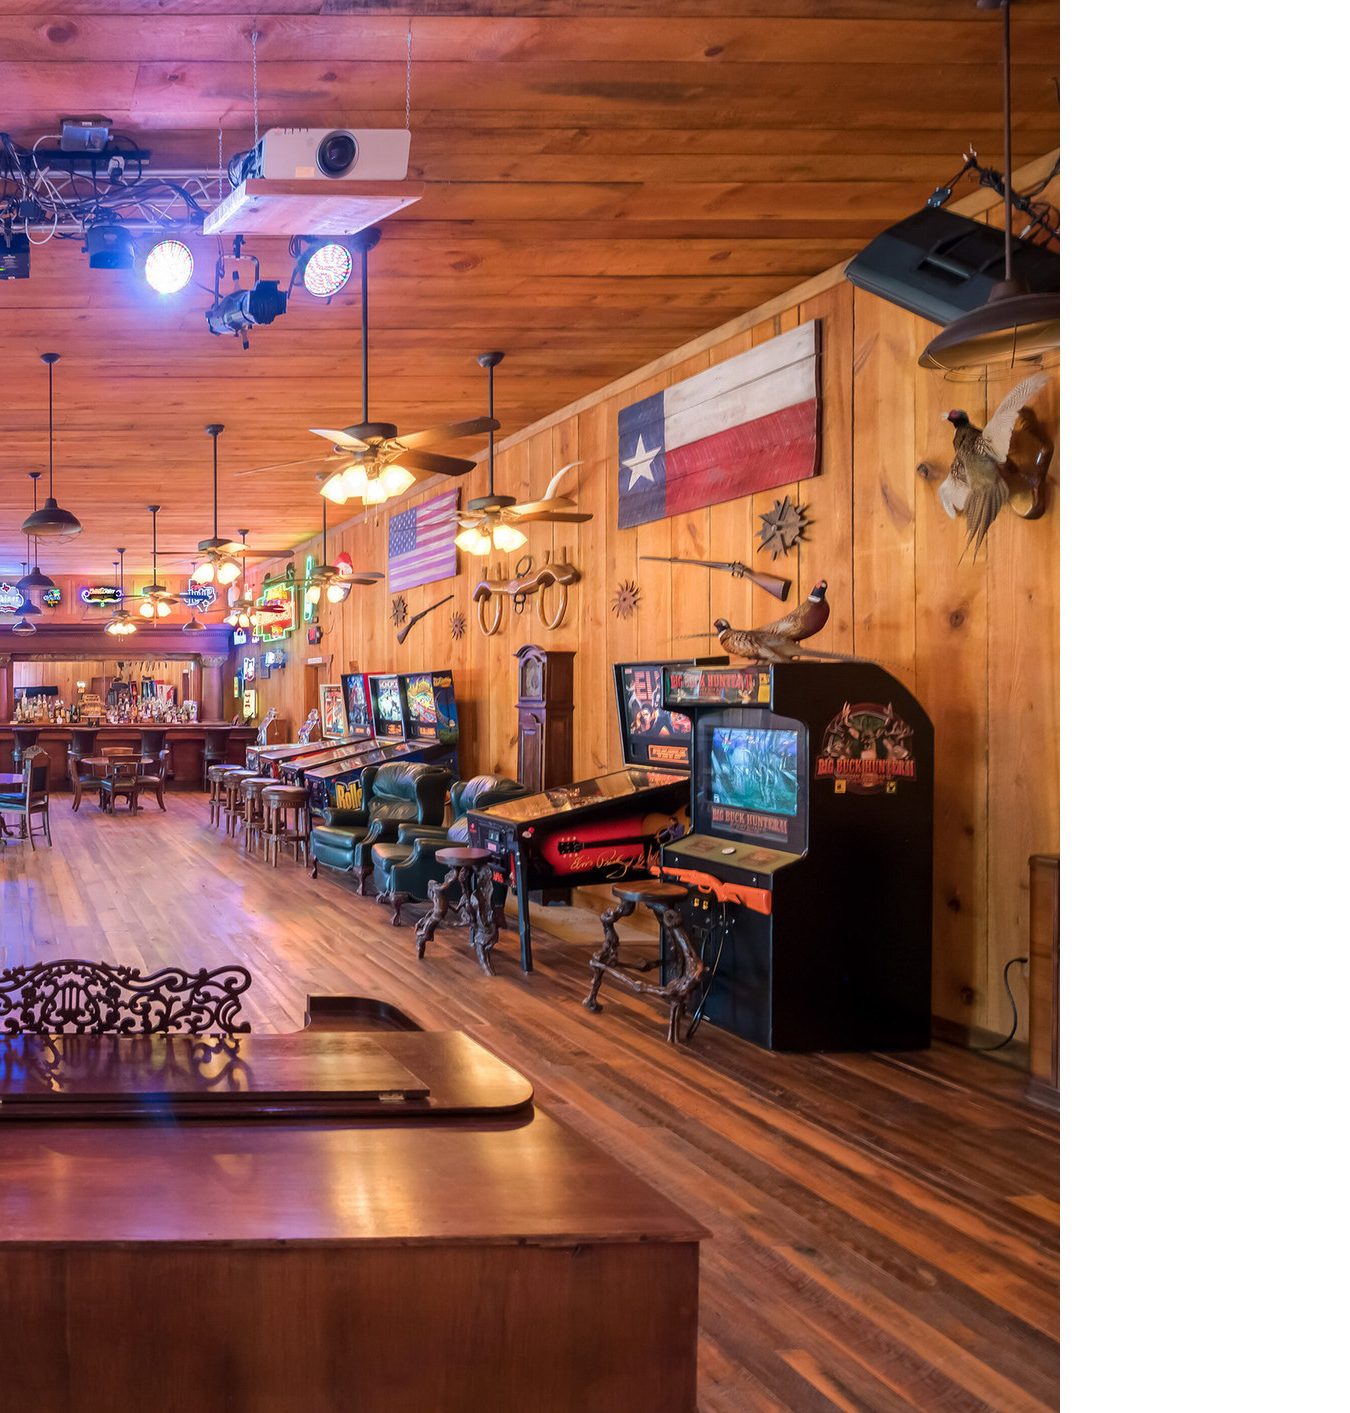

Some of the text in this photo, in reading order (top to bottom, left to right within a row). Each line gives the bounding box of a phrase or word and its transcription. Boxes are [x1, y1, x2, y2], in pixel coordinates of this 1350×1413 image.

[670, 674, 683, 689] BIG
[818, 758, 834, 775] BIG
[836, 758, 862, 773] BUCK
[336, 780, 363, 810] Rolle
[712, 807, 724, 821] BIG
[725, 809, 745, 824] BUCK
